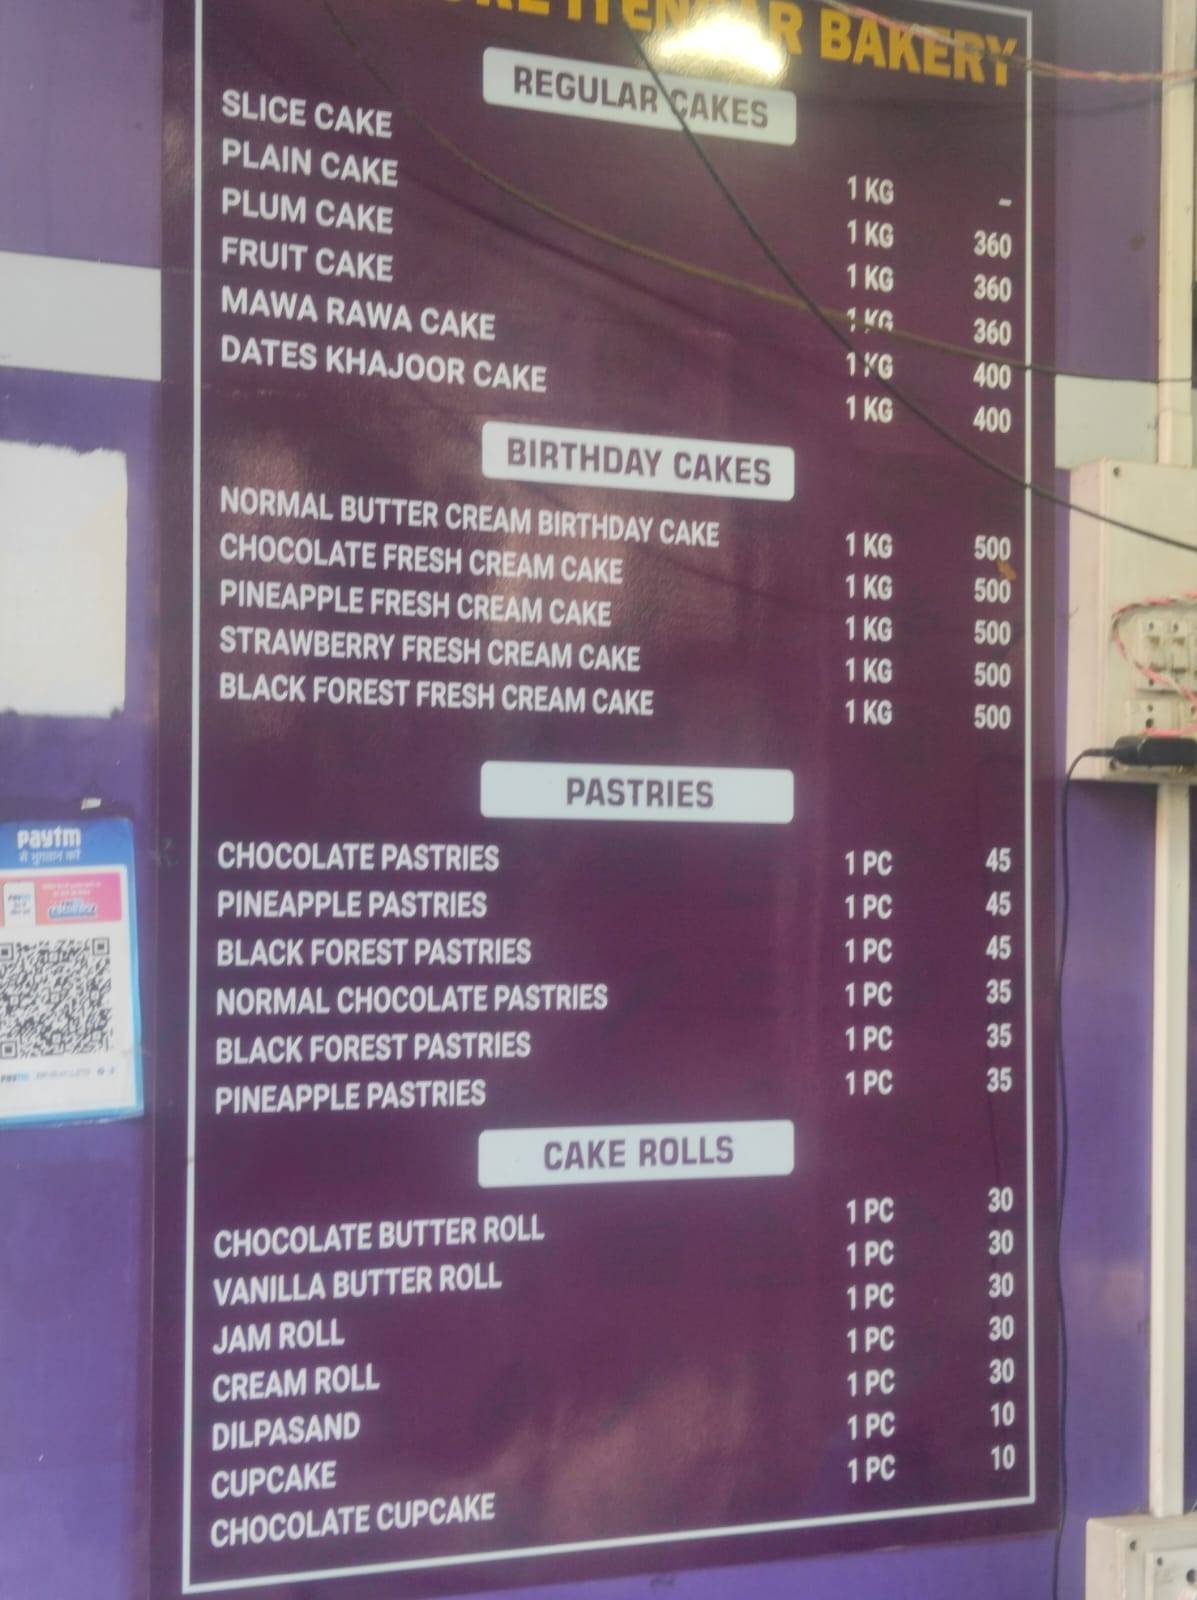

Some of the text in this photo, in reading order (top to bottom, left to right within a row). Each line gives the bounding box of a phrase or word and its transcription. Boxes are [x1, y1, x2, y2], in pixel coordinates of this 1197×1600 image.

[820, 8, 1017, 87] BAKERY
[513, 64, 770, 130] REGULAR CAKES
[221, 89, 393, 139] SLICE CAKE
[222, 137, 399, 187] PLAIN CAKE
[847, 175, 895, 205] 1 KG
[221, 187, 394, 235] PLUM CAKE
[847, 218, 895, 249] 1 KG
[973, 229, 1013, 259] 360
[221, 236, 394, 282] FRUIT CAKE
[846, 262, 894, 293] 1 KG
[973, 273, 1013, 303] 360
[221, 285, 496, 341] MAWA RAWA CAKE
[846, 306, 894, 335] 1 KG
[973, 317, 1012, 347] 360
[221, 334, 547, 393] DATES KHAJOOR CAKE
[846, 351, 894, 380] 1 KG
[972, 361, 1012, 390] 400
[845, 394, 894, 424] 1 KG
[972, 405, 1012, 434] 400
[507, 437, 771, 486] BIRTHDAY CAKES
[220, 486, 720, 548] NORMAL BUTTER CREAM BIRTHDAY CAKE
[219, 533, 624, 585] CHOCOLATE FRESH CREAM CAKE
[845, 531, 894, 560] 1 KG
[973, 534, 1012, 561] 500
[845, 573, 894, 601] 1 KG
[973, 577, 1012, 604] 500
[220, 579, 612, 627] PINEAPPLE FRESH CREAM CAKE
[845, 615, 893, 643] 1 KG
[973, 619, 1012, 646] 500
[219, 625, 641, 673] STRAWBERRY FRESH CREAM CAKE
[845, 656, 893, 684] 1 KG
[973, 661, 1012, 688] 500
[219, 671, 655, 716] BLACK FOREST FRESH CREAM CAKE
[845, 698, 893, 726] 1 KG
[973, 703, 1012, 730] 500
[566, 776, 714, 809] PASTRIES
[217, 841, 500, 872] CHOCOLATE PASTRIES
[844, 849, 893, 877] 1 PC
[984, 846, 1012, 873] 45
[217, 890, 488, 918] PINEAPPLE PASTRIES
[844, 893, 893, 920] 1 PC
[985, 890, 1012, 917] 45
[216, 937, 532, 967] BLACK FOREST PASTRIES
[844, 937, 893, 964] 1 PC
[985, 934, 1012, 961] 45
[216, 982, 609, 1016] NORMAL CHOCOLATE PASTRIES
[844, 980, 893, 1008] 1 PC
[985, 978, 1012, 1005] 35
[215, 1031, 532, 1066] BLACK FOREST PASTRIES
[845, 1024, 894, 1052] 1 PC
[986, 1022, 1013, 1049] 35
[845, 1068, 894, 1096] 1 PC
[986, 1066, 1013, 1093] 35
[215, 1079, 487, 1114] PINEAPPLE PASTRIES
[543, 1135, 734, 1171] CAKE ROLLS
[846, 1196, 895, 1225] 1 PC
[987, 1186, 1014, 1213] 30
[213, 1213, 546, 1258] CHOCOLATE BUTTER ROLL
[988, 1228, 1015, 1256] 30
[846, 1238, 895, 1268] 1 PC
[212, 1262, 503, 1306] VANILLA BUTTER ROLL
[846, 1281, 895, 1311] 1 PC
[988, 1271, 1015, 1299] 30
[212, 1318, 346, 1355] JAM ROLL
[846, 1324, 895, 1354] 1 PC
[988, 1314, 1015, 1342] 30
[211, 1362, 381, 1403] CREAM ROLL
[846, 1367, 896, 1398] 1 PC
[988, 1357, 1015, 1385] 30
[847, 1410, 896, 1441] 1 PC
[990, 1400, 1016, 1428] 10
[211, 1411, 361, 1451] DILPASAND
[847, 1453, 896, 1484] 1 PC
[990, 1443, 1016, 1471] 10
[210, 1460, 337, 1499] CUPCAKE
[210, 1494, 496, 1547] CHOCOLATE CUPCAKE
